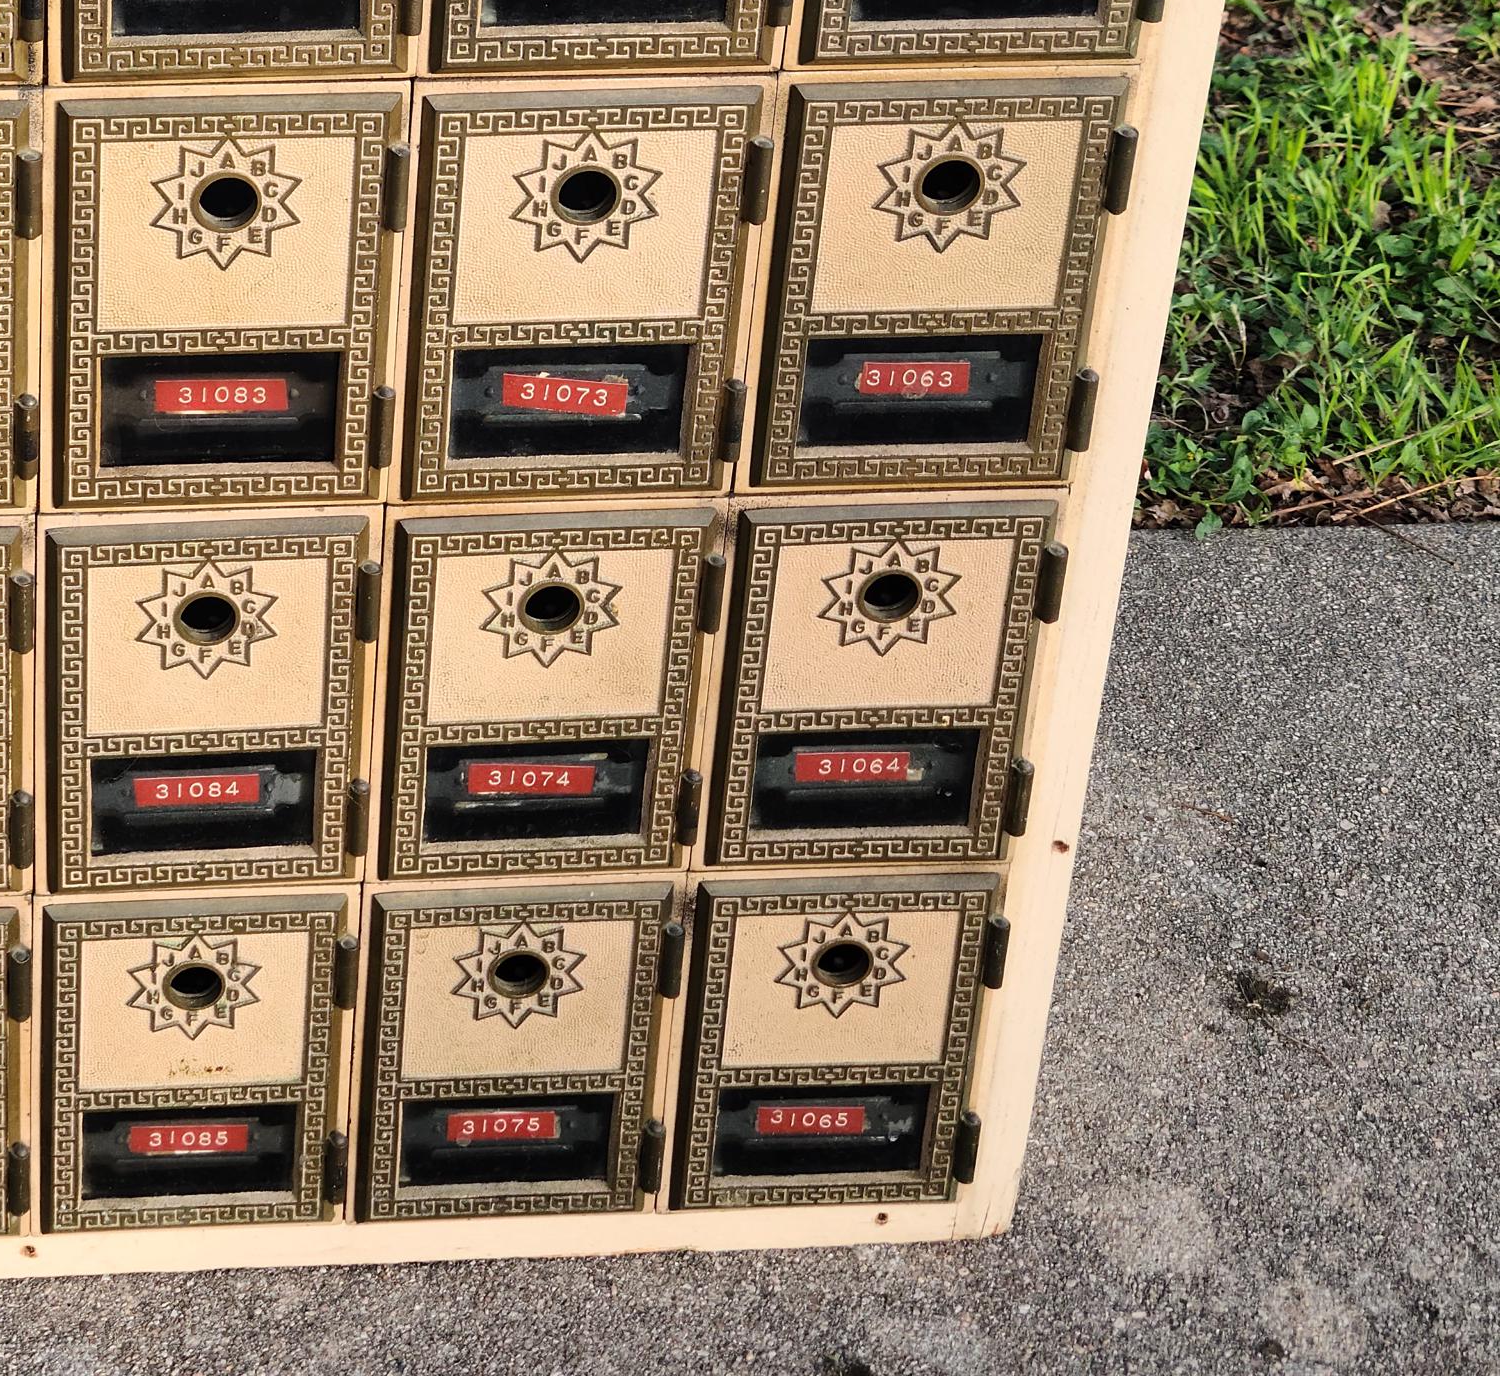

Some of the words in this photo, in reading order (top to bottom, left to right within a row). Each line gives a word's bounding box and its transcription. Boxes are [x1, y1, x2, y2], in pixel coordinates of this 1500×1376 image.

[947, 135, 963, 151] A
[979, 143, 993, 159] B
[918, 144, 932, 160] J
[987, 165, 1000, 181] C
[895, 191, 909, 208] H
[983, 189, 997, 206] D
[908, 211, 923, 227] G
[935, 219, 952, 235] F
[967, 210, 982, 227] E
[867, 369, 952, 387] 31063
[179, 387, 266, 404] 31083
[521, 384, 607, 406] 31073
[819, 758, 900, 774] 31064
[489, 770, 570, 787] 31074
[156, 782, 239, 799] 31084
[463, 1117, 540, 1134] 31075
[771, 1109, 848, 1127] 31065
[150, 1130, 228, 1147] 31085
